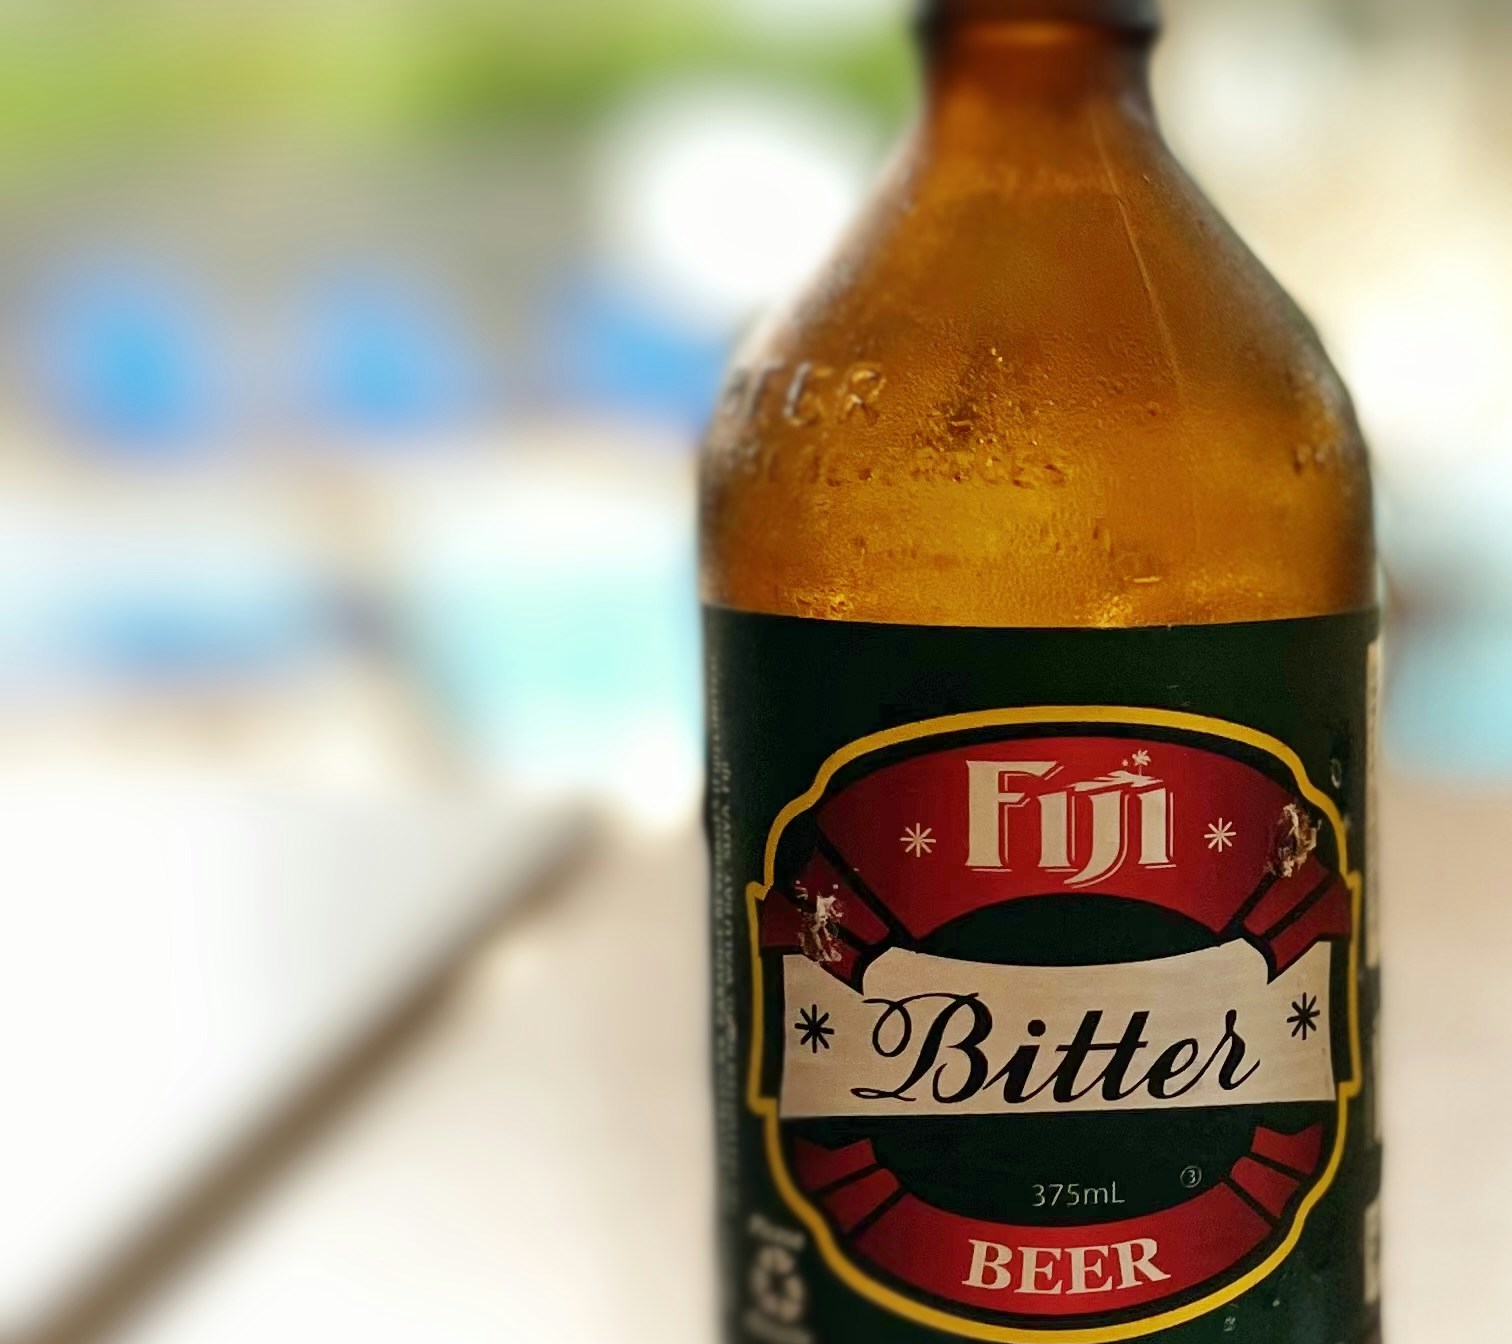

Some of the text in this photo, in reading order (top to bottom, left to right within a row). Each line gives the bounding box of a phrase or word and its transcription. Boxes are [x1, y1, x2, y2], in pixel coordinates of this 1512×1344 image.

[850, 992, 1260, 1104] Bitter
[1032, 1180, 1125, 1207] 375mL
[961, 1238, 1171, 1295] BEER
